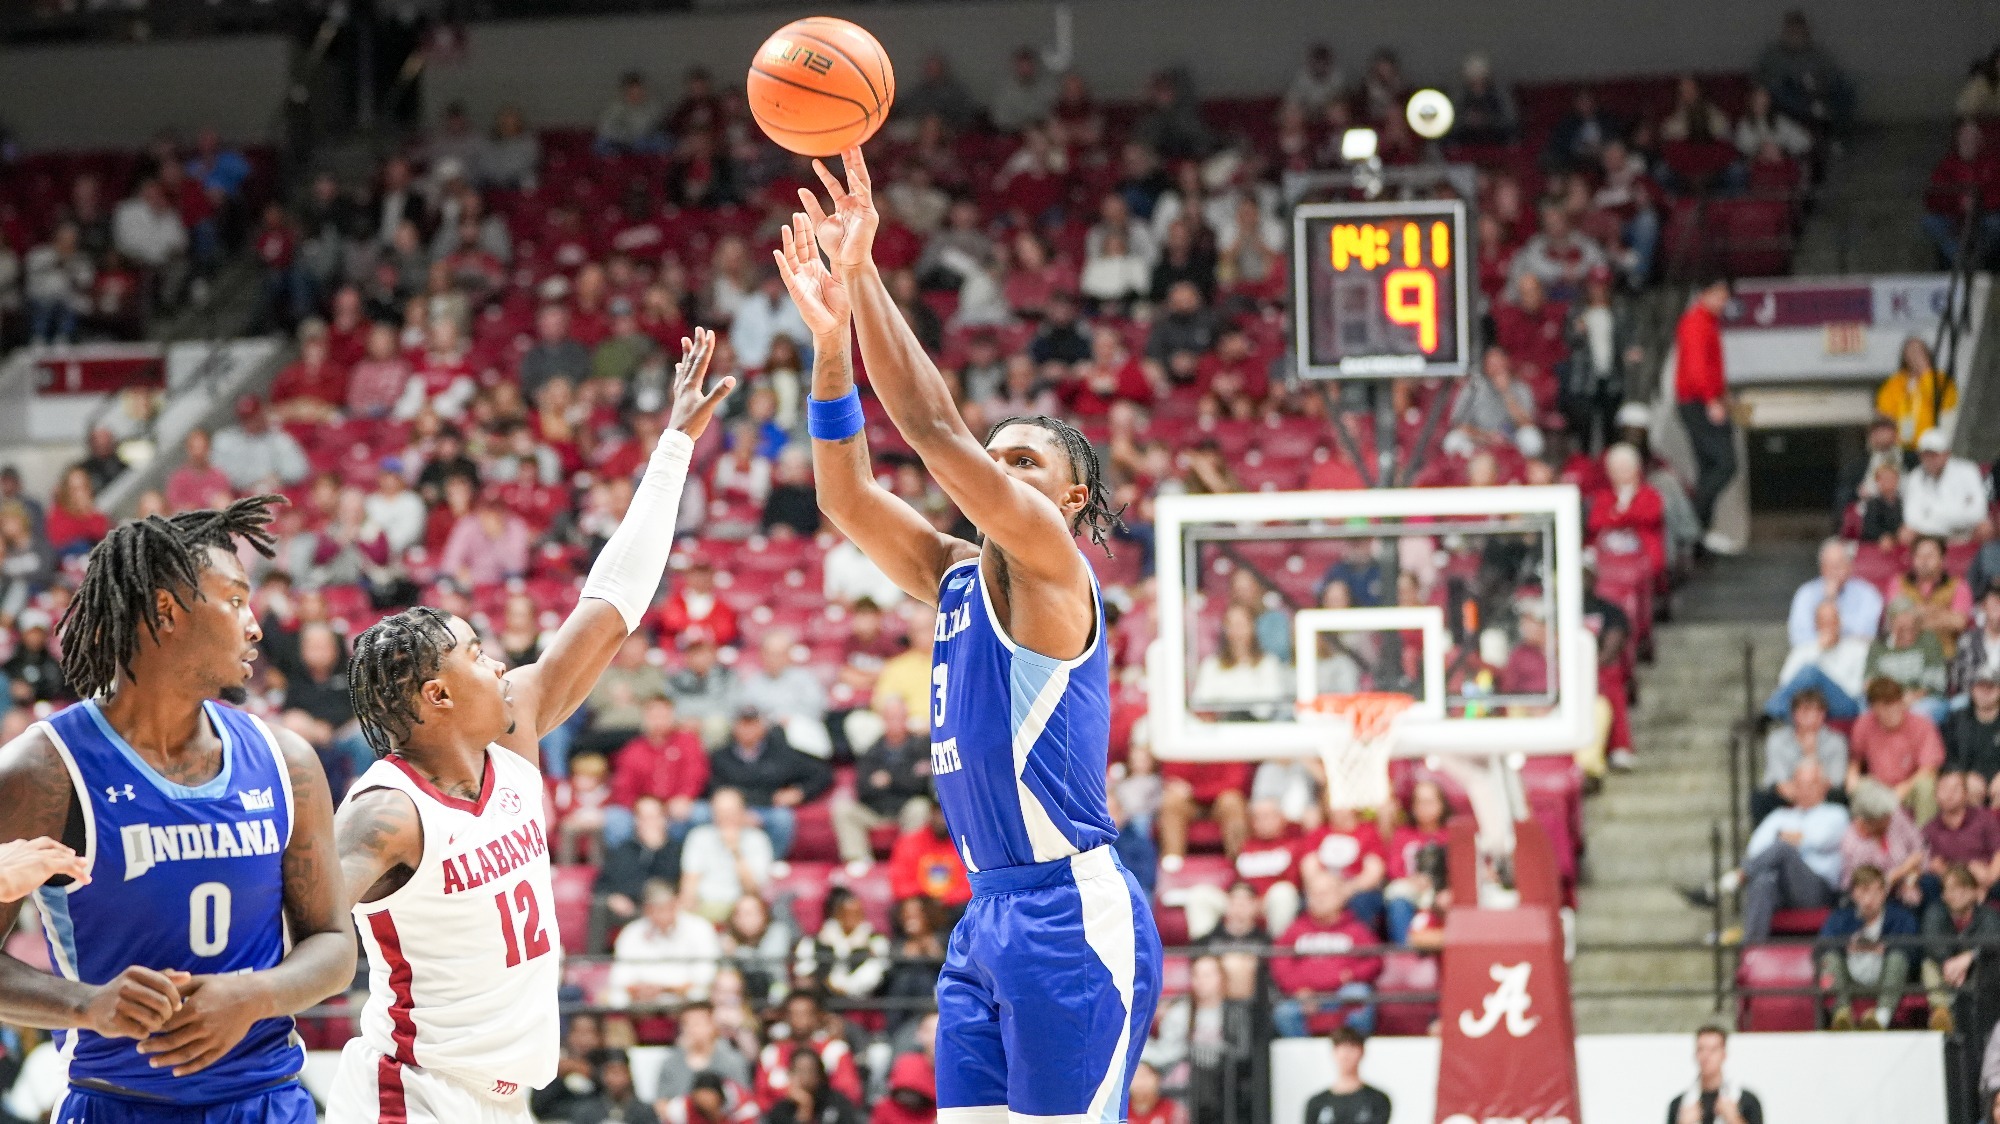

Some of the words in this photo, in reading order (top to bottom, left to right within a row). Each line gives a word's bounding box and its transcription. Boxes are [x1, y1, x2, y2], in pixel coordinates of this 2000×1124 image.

[766, 39, 834, 76] ELIT
[1331, 221, 1450, 272] 14:11
[1384, 267, 1438, 355] 9
[933, 662, 949, 728] 3
[931, 736, 963, 776] TATE
[121, 819, 280, 870] INDIANA
[442, 818, 546, 895] ALABAMA
[189, 881, 232, 957] 0
[494, 879, 551, 968] 12
[1458, 961, 1542, 1039] A
